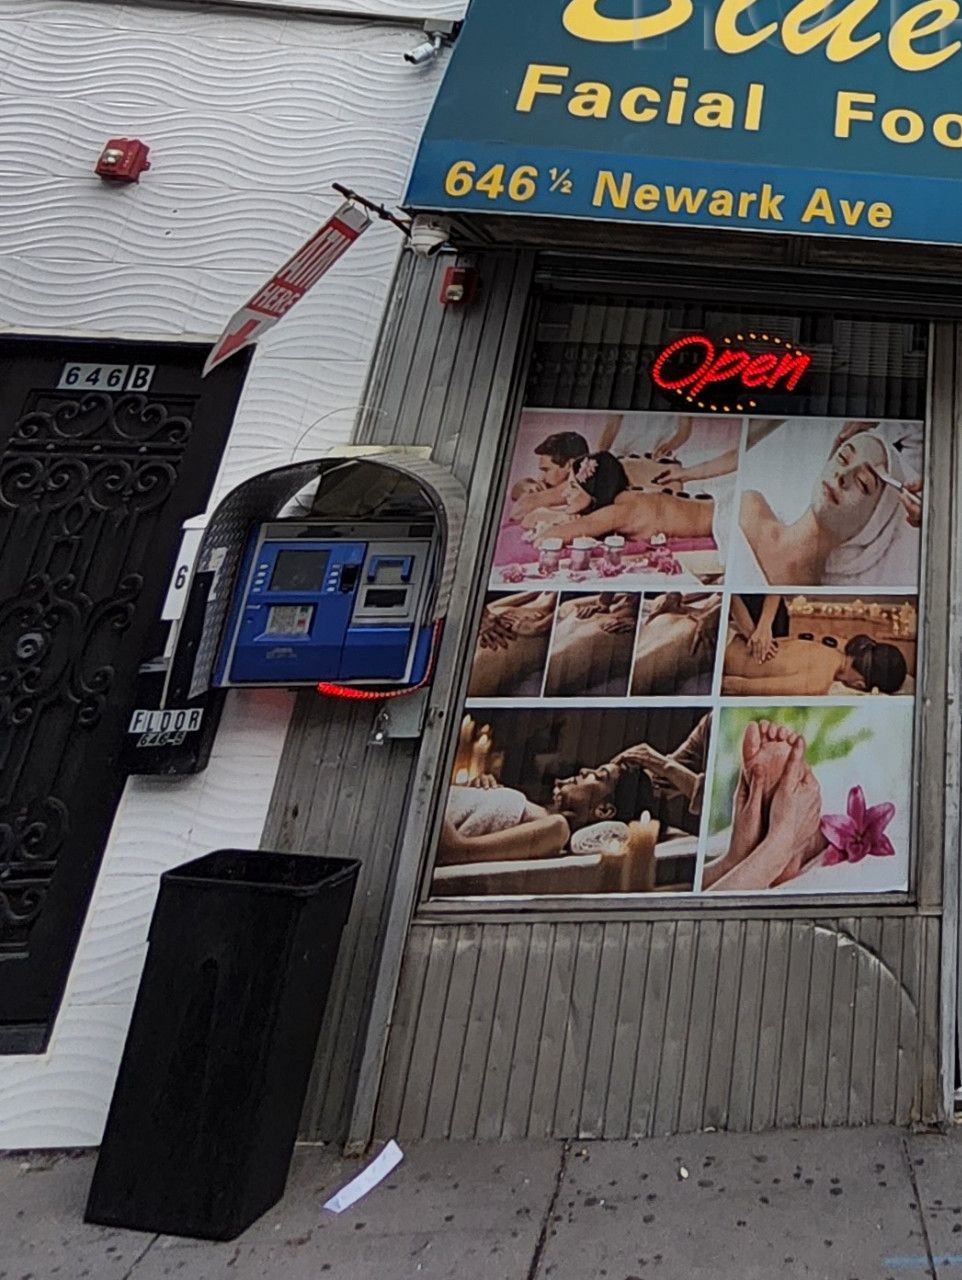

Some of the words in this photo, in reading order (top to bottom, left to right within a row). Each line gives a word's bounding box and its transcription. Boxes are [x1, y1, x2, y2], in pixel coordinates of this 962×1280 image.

[515, 64, 765, 131] Facial
[444, 160, 537, 201] 646
[592, 170, 784, 221] Newark
[801, 187, 894, 229] Ave
[277, 226, 352, 290] ATM
[250, 282, 303, 314] HERE
[652, 335, 813, 397] Open
[174, 565, 188, 589] 6
